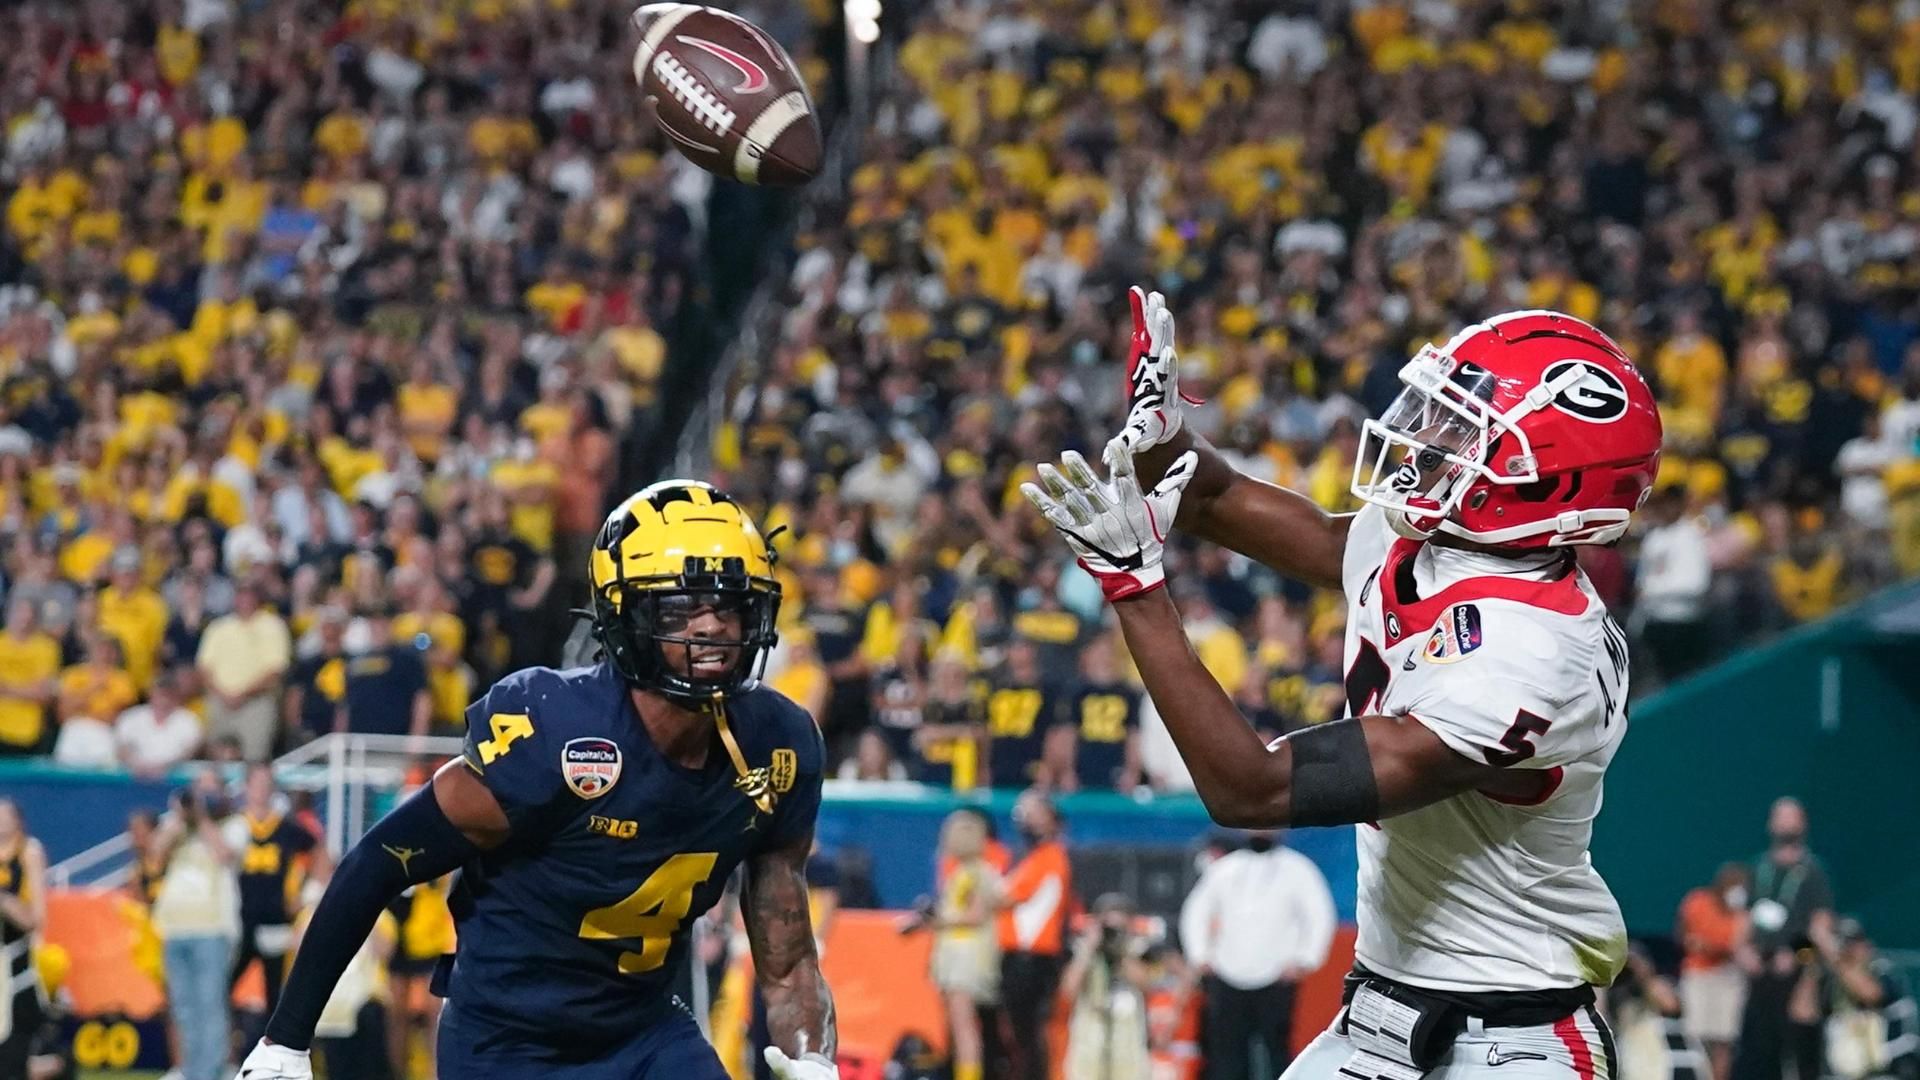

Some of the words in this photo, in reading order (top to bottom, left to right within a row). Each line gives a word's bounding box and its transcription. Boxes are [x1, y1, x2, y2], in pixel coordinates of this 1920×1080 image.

[704, 557, 724, 572] M
[476, 712, 534, 766] 4
[1483, 707, 1553, 768] 5
[775, 765, 791, 779] 42
[577, 851, 719, 975] 4
